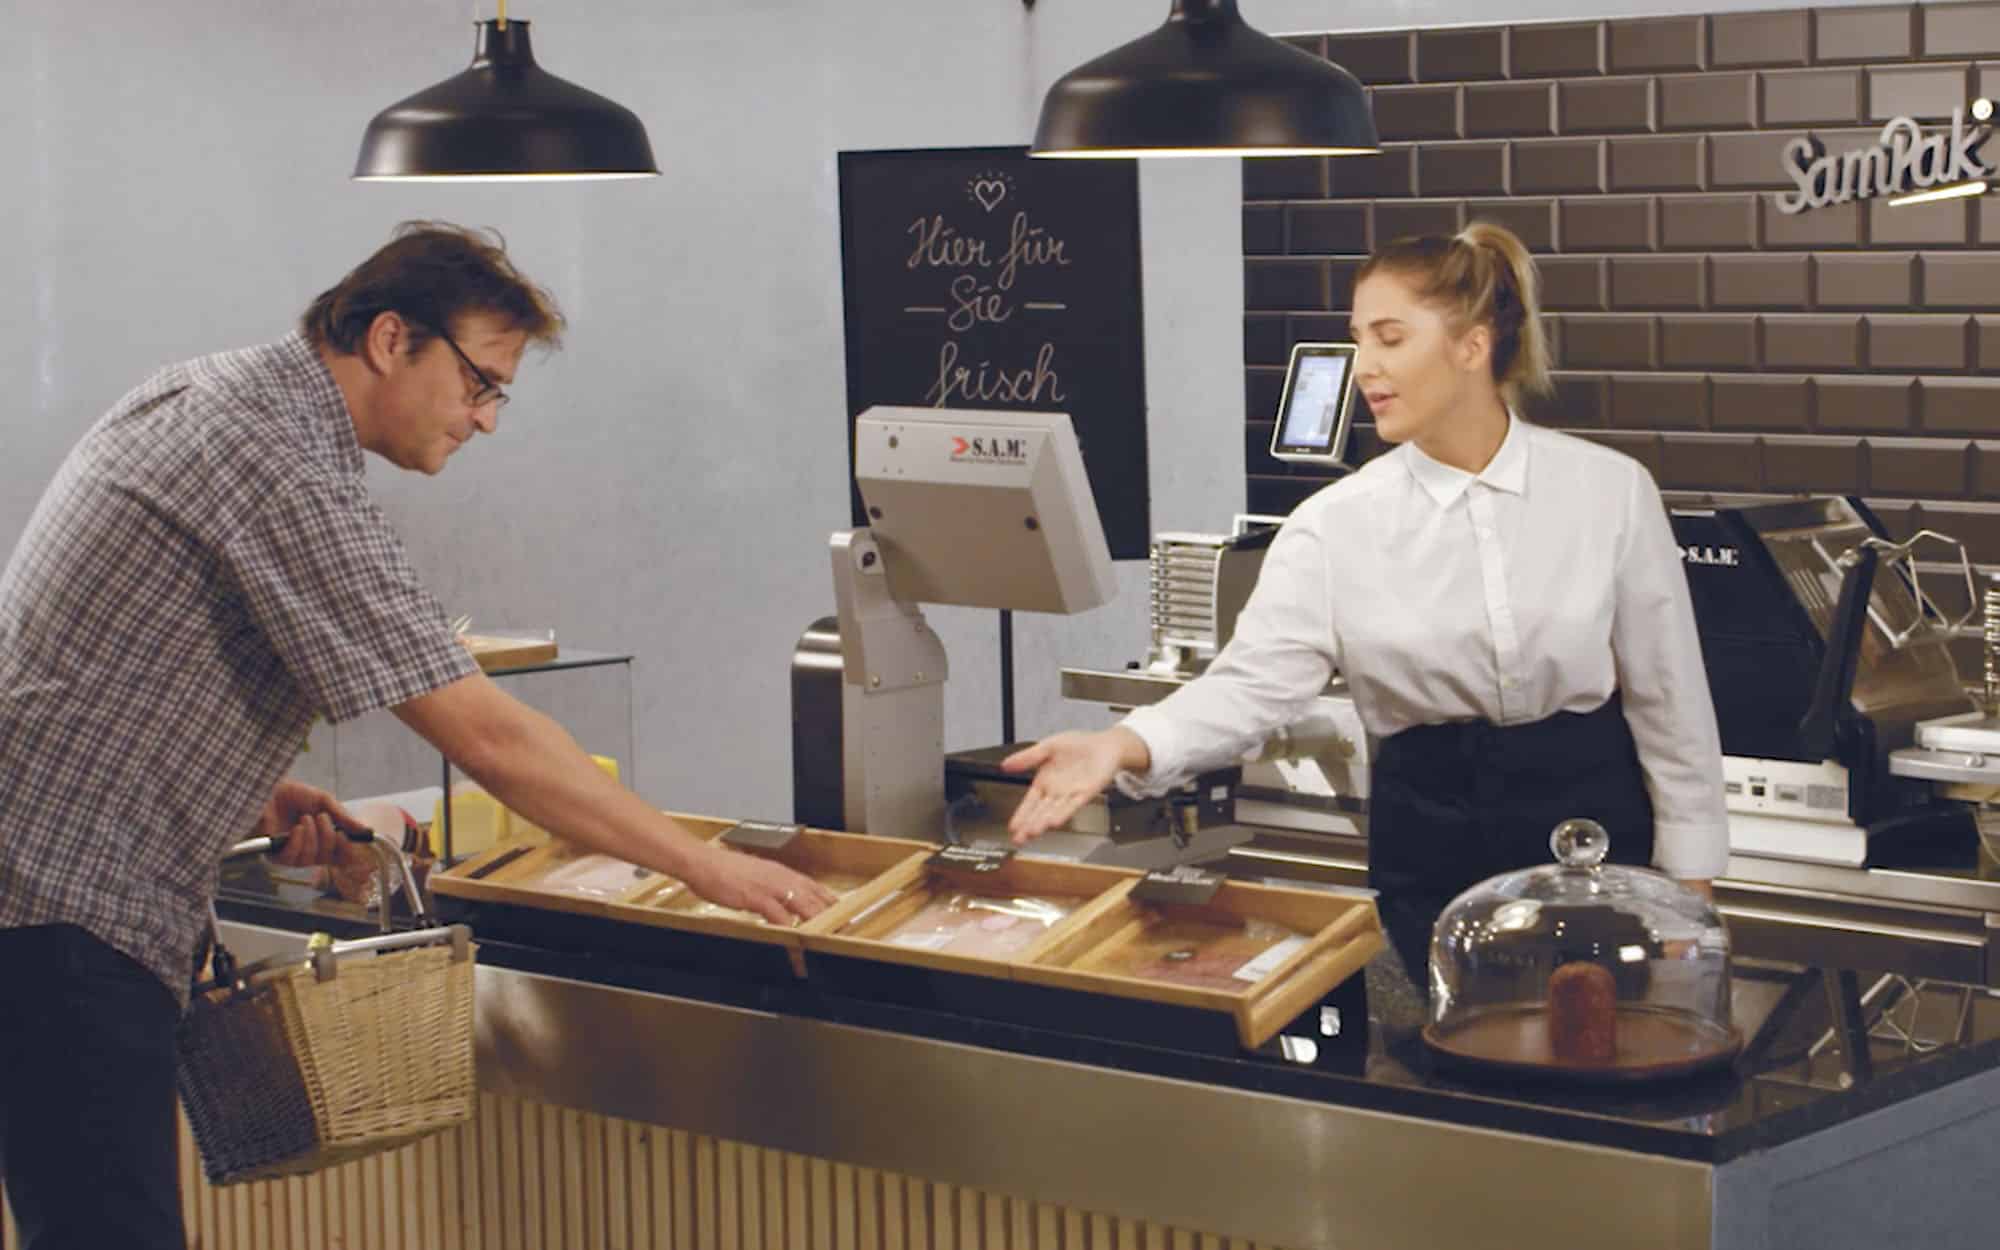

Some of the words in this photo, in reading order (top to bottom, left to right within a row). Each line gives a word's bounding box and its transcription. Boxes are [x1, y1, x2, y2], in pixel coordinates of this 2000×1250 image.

[1776, 107, 1985, 214] SamPak
[907, 214, 991, 269] Hier
[948, 274, 1012, 332] Sie
[925, 341, 1066, 409] frisch
